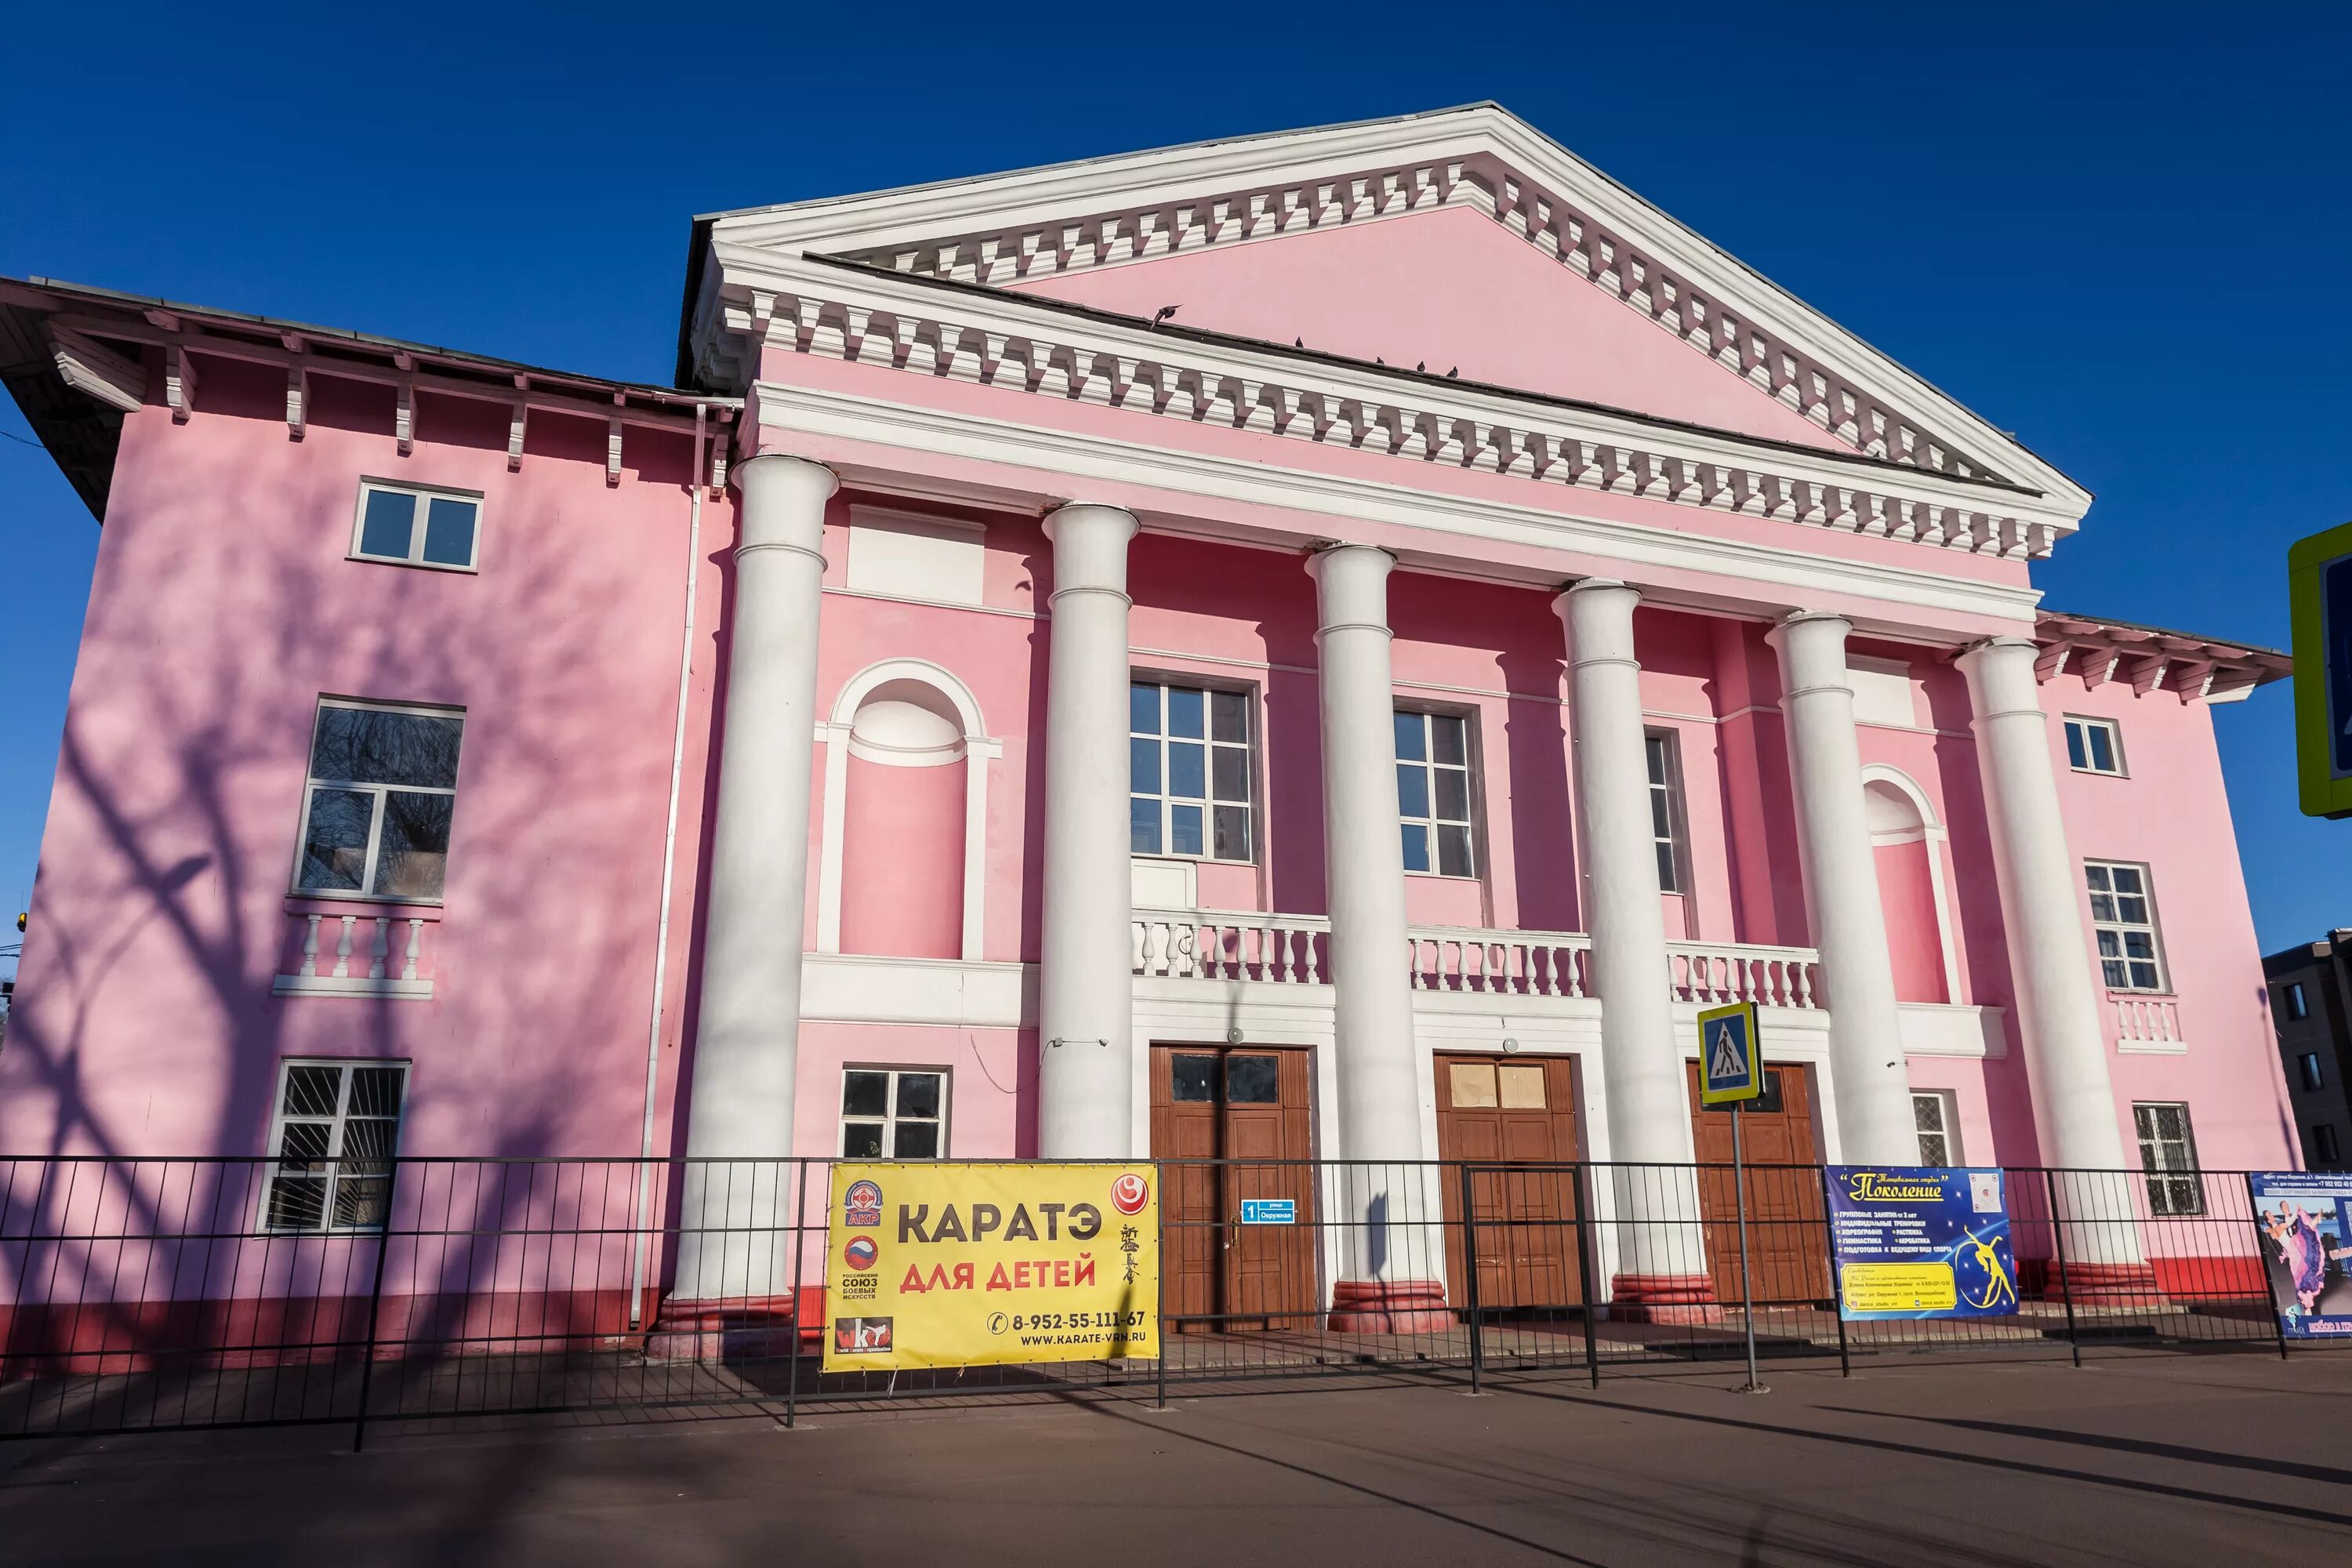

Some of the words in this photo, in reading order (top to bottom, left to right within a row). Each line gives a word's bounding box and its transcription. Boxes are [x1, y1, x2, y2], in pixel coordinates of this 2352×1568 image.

[1247, 1205, 1254, 1218] 1
[848, 1214, 879, 1225] АКР
[898, 1203, 1102, 1243] КАРАТЭ
[899, 1262, 975, 1294] ДЛЯ
[985, 1252, 1095, 1291] ДЕТЕЙ
[842, 1278, 877, 1287] СОЮЗ
[1012, 1311, 1145, 1330] 8-952-55-111-67
[1021, 1332, 1145, 1345] WWW.KARATE-VRN.RU
